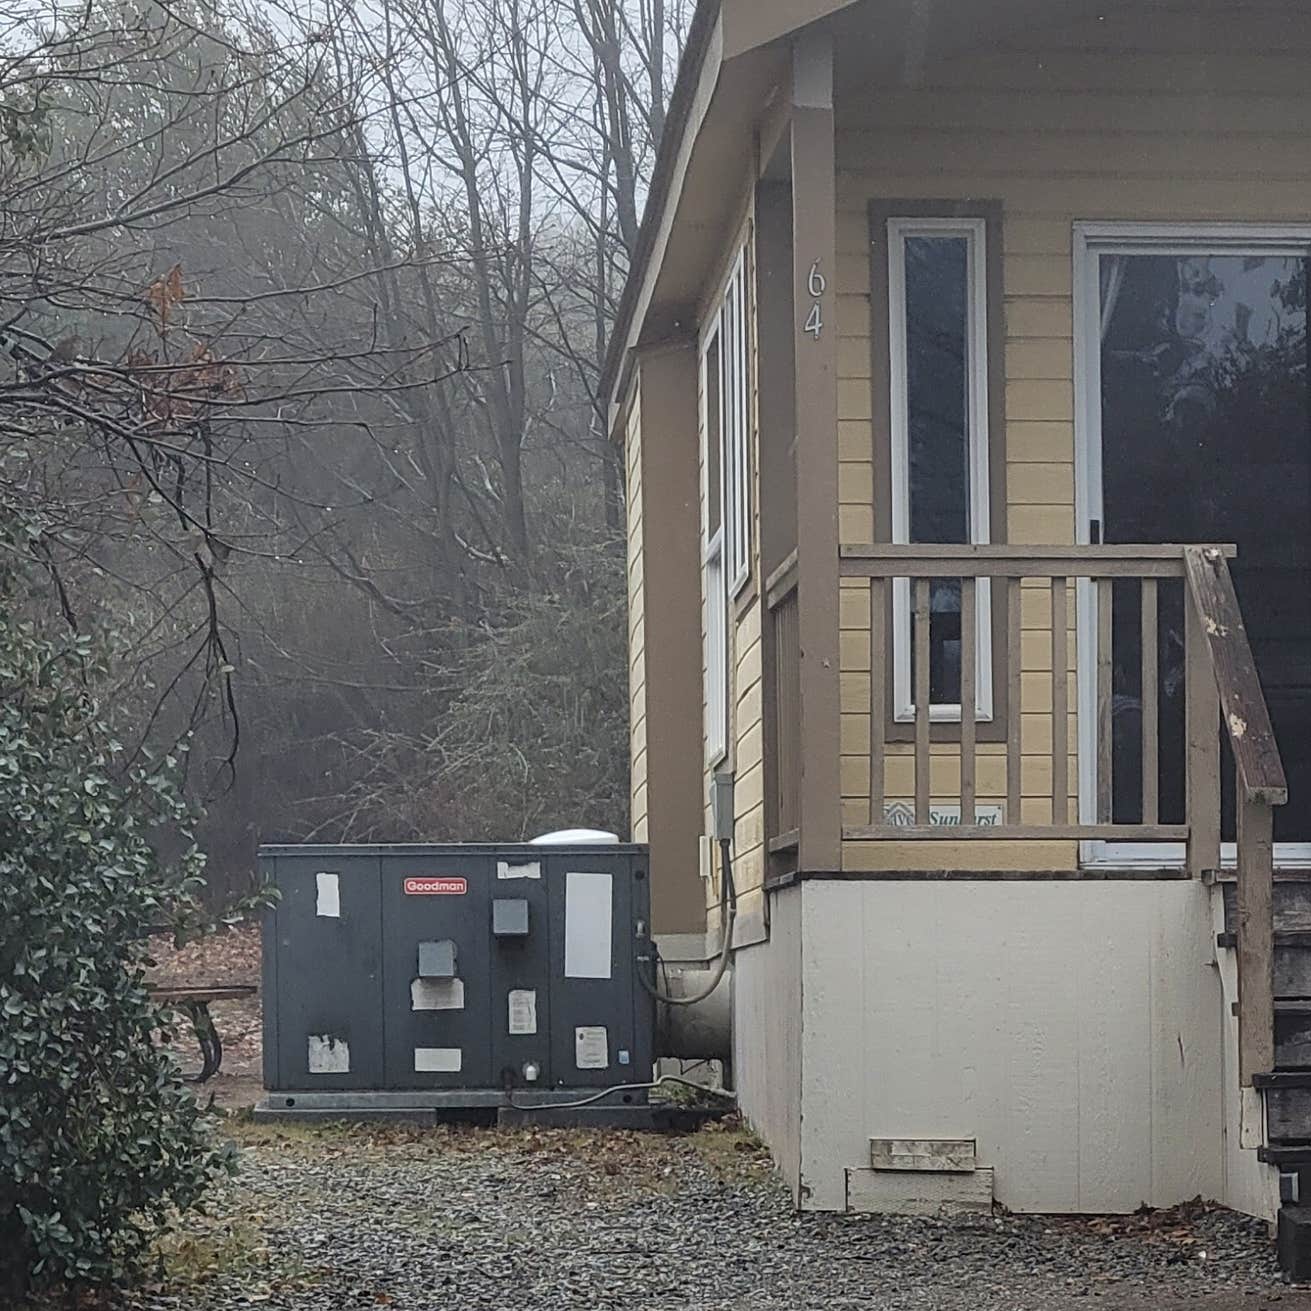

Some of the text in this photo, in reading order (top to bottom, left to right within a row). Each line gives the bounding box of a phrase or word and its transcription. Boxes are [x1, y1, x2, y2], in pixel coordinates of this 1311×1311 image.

[804, 257, 826, 340] 64
[929, 811, 997, 826] Sunrst
[406, 880, 464, 891] Goodman
